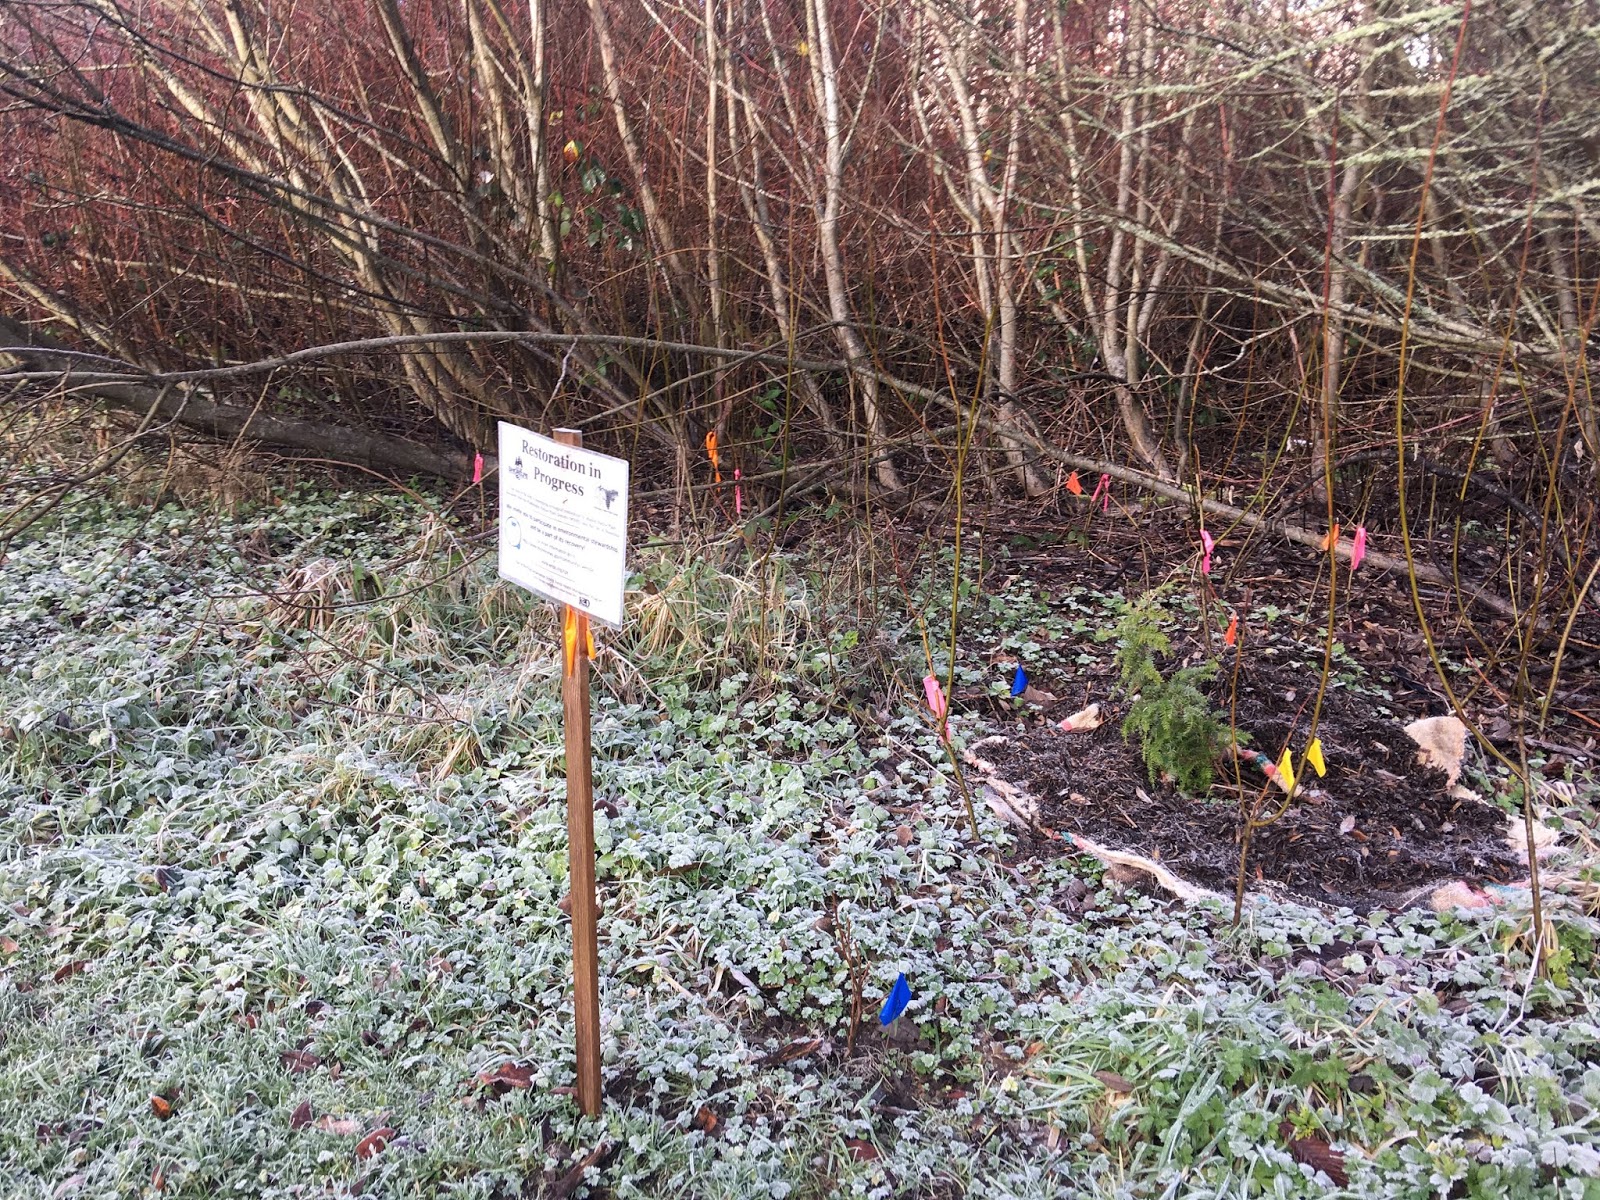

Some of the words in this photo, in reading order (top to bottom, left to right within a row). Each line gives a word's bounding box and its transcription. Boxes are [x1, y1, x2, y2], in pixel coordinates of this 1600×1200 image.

[522, 439, 585, 475] Restoration
[589, 462, 601, 479] in
[534, 466, 584, 496] Progress
